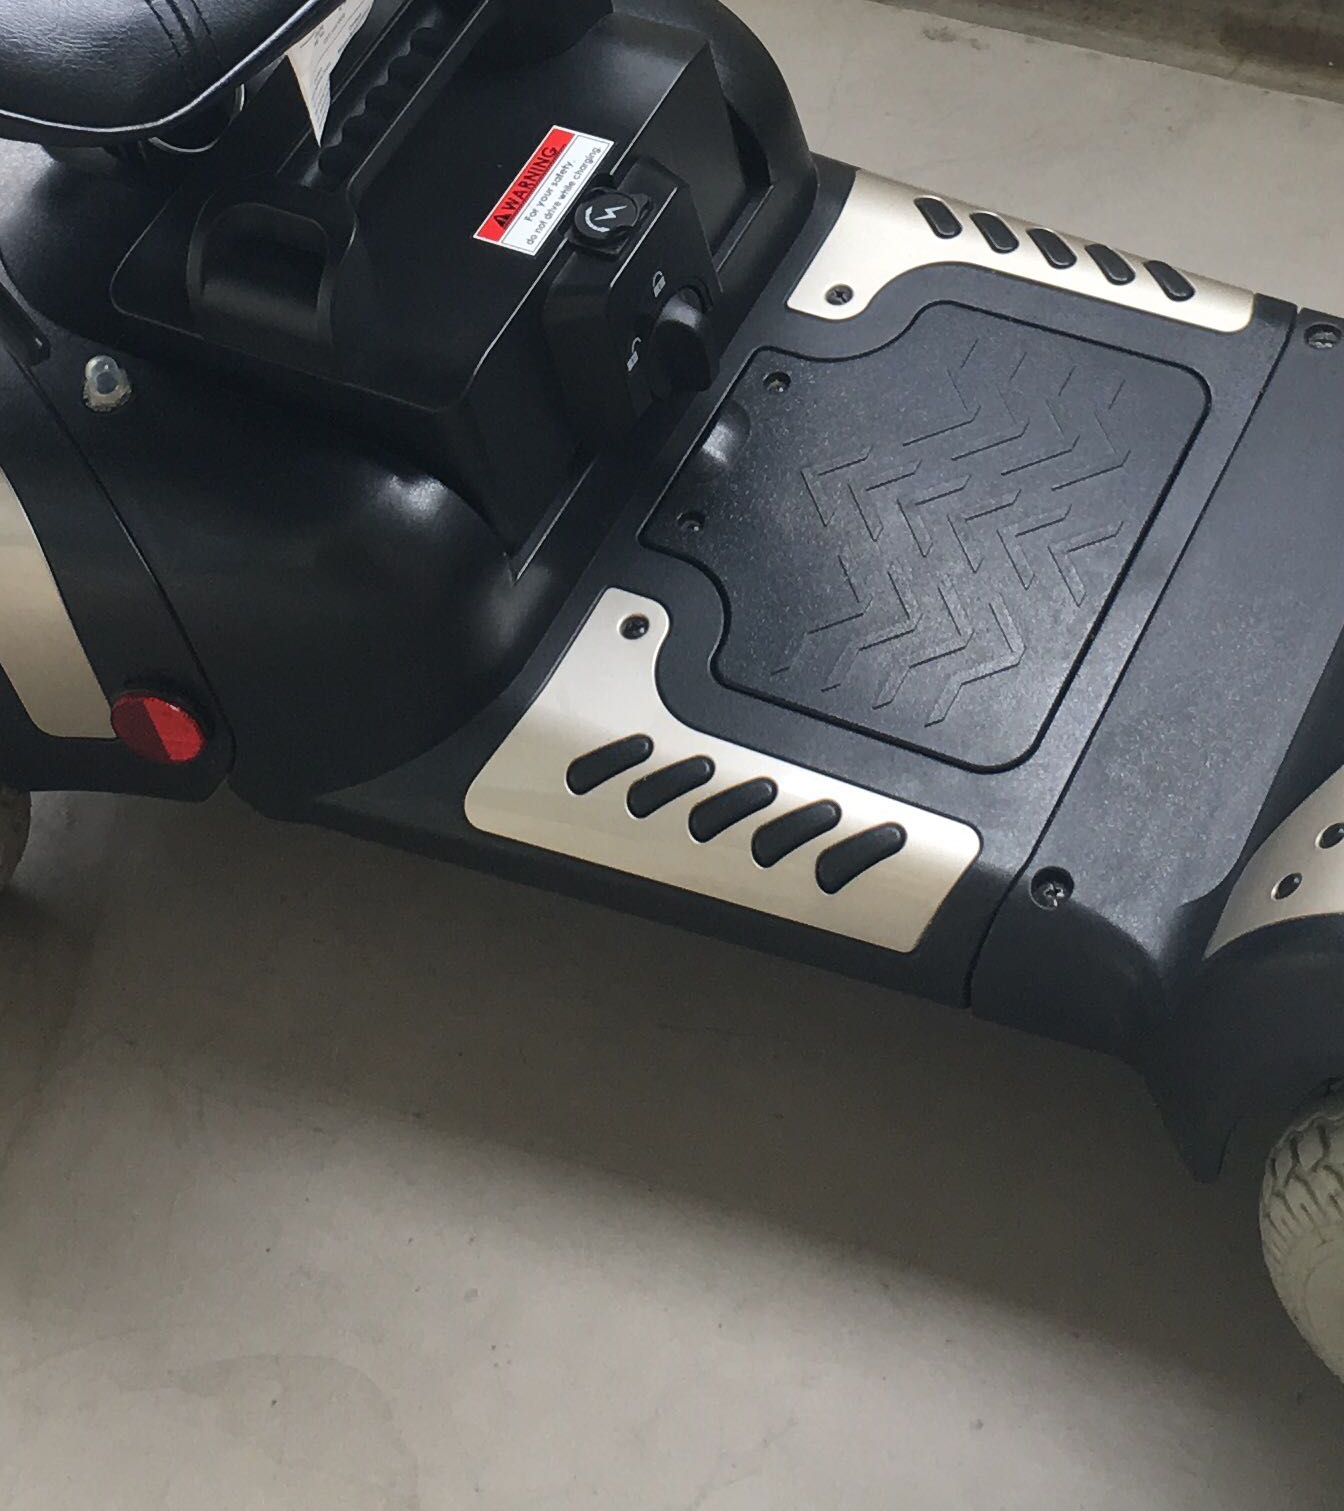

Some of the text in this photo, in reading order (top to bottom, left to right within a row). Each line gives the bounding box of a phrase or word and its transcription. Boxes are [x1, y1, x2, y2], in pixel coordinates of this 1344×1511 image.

[501, 147, 559, 212] WARNING
[524, 208, 540, 223] For
[536, 187, 553, 207] your
[526, 234, 537, 245] do
[535, 221, 547, 234] not
[544, 201, 562, 220] drive
[558, 180, 576, 200] while
